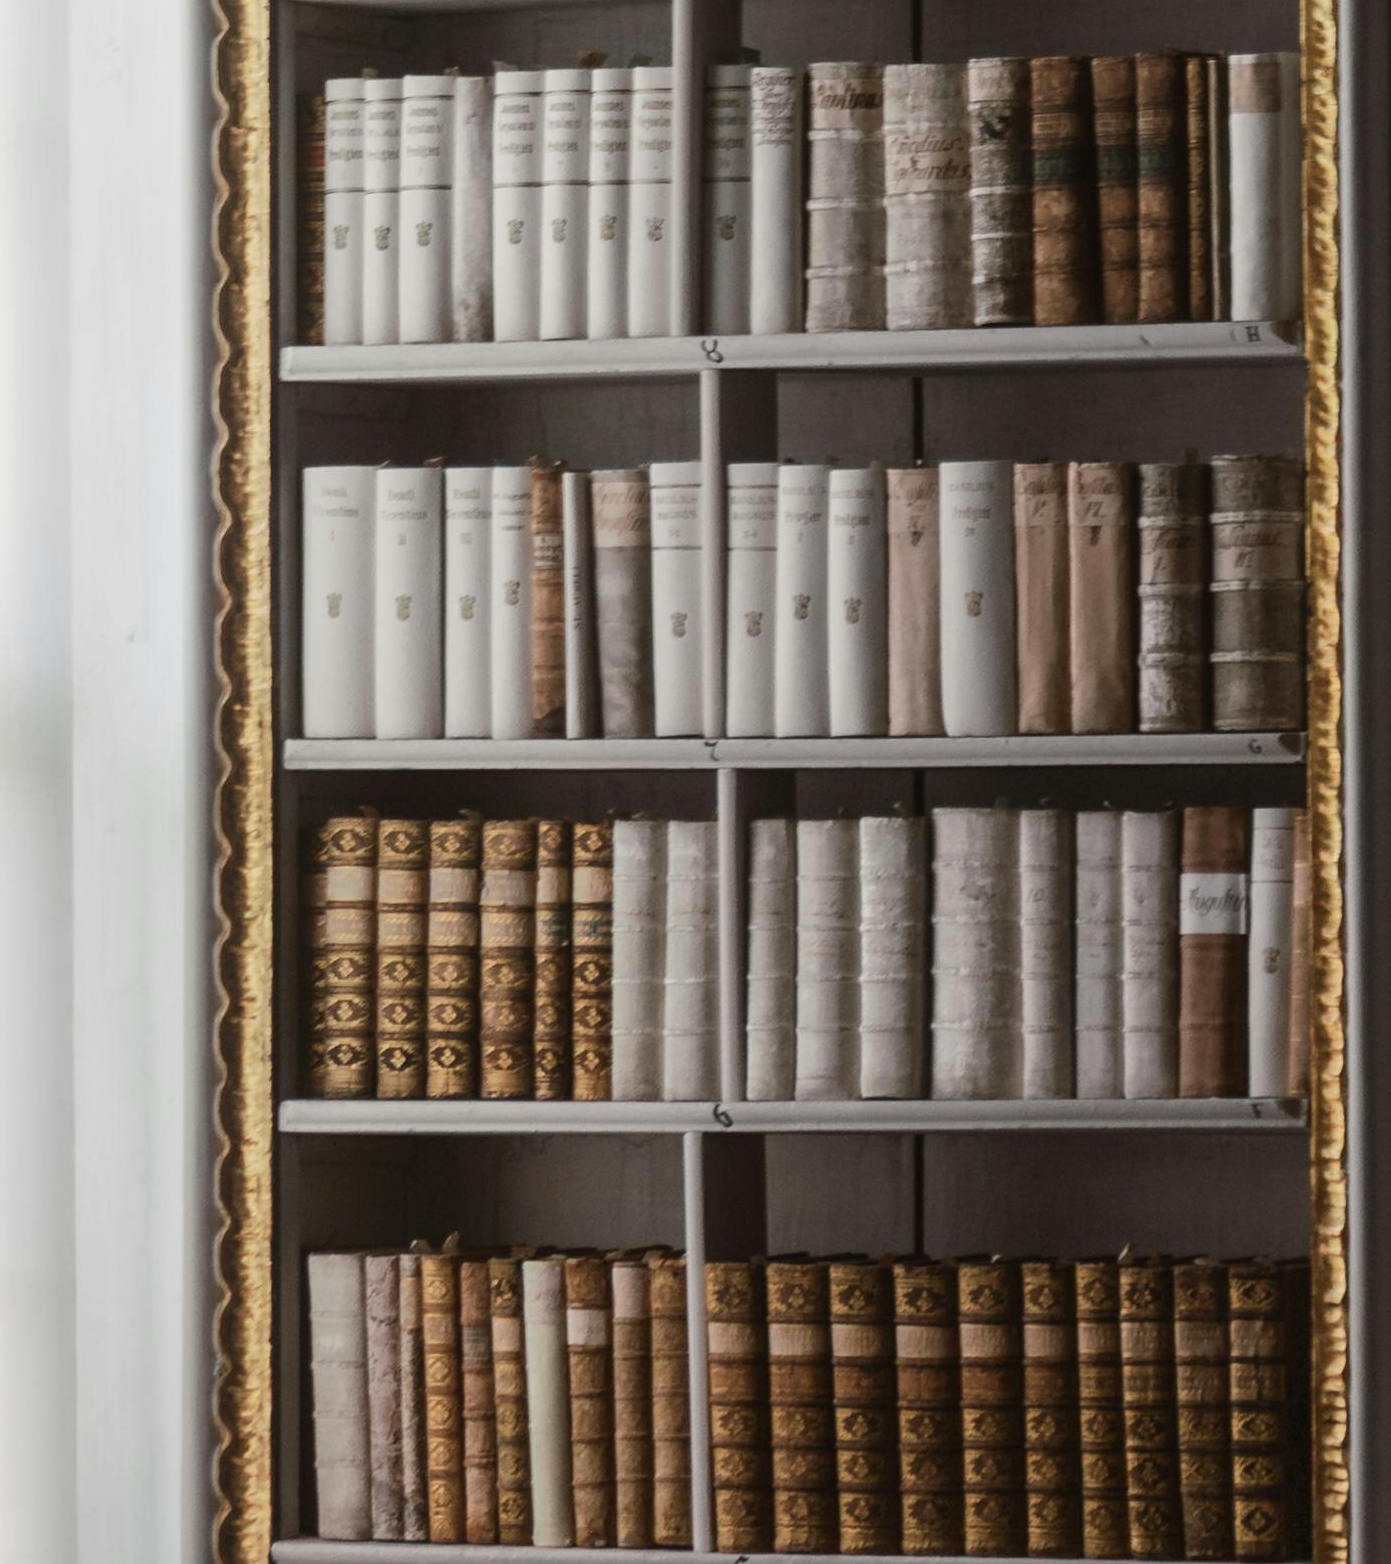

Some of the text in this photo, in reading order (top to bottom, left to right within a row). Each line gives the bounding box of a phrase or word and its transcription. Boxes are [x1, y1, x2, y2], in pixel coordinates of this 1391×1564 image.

[1245, 325, 1261, 343] H
[700, 338, 724, 364] 8
[703, 740, 721, 762] 7
[1247, 738, 1263, 755] G
[712, 1103, 735, 1128] 6
